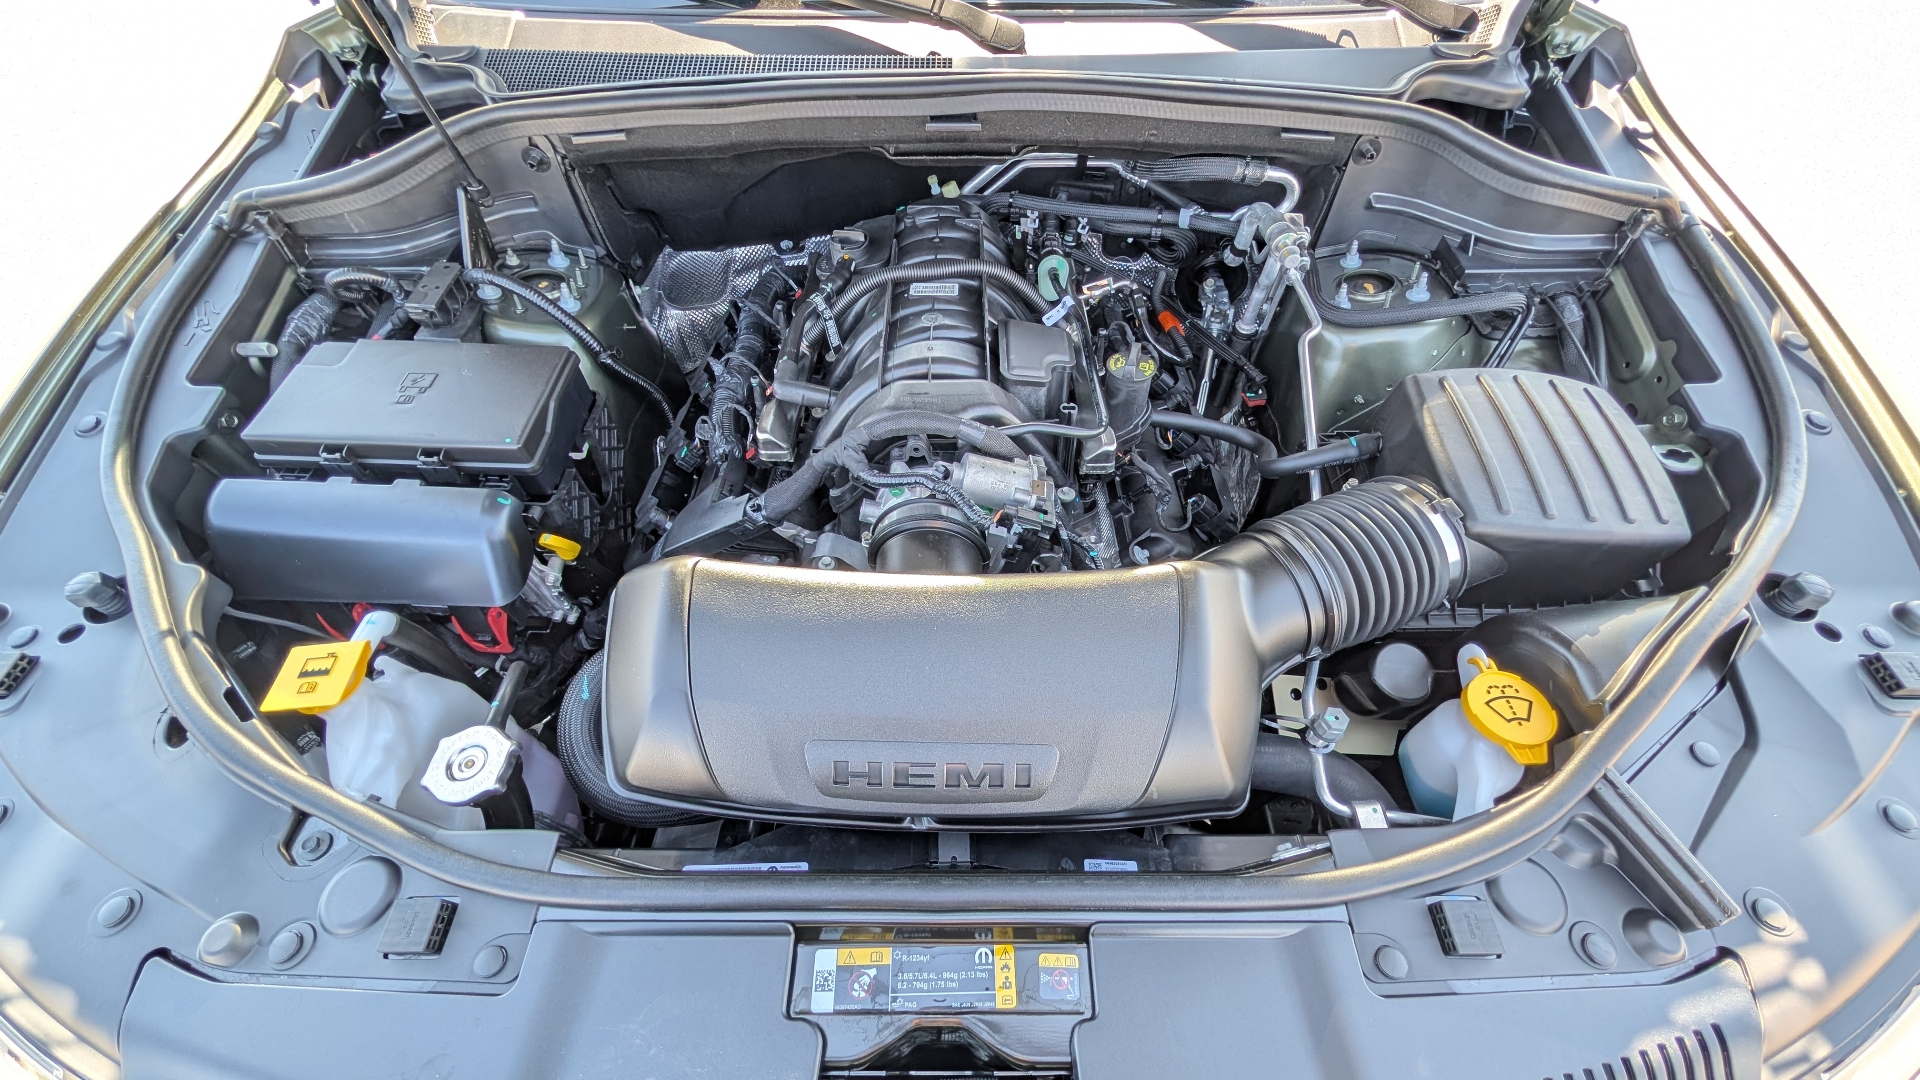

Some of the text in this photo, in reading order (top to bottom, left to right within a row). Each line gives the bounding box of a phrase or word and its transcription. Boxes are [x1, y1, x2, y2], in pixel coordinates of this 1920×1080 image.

[832, 760, 1032, 789] HEMI
[902, 954, 930, 963] R-1234yf
[959, 971, 974, 980] (2.13
[976, 971, 989, 979] lbs)
[929, 981, 945, 989] (1.75
[946, 981, 959, 989] lbs)
